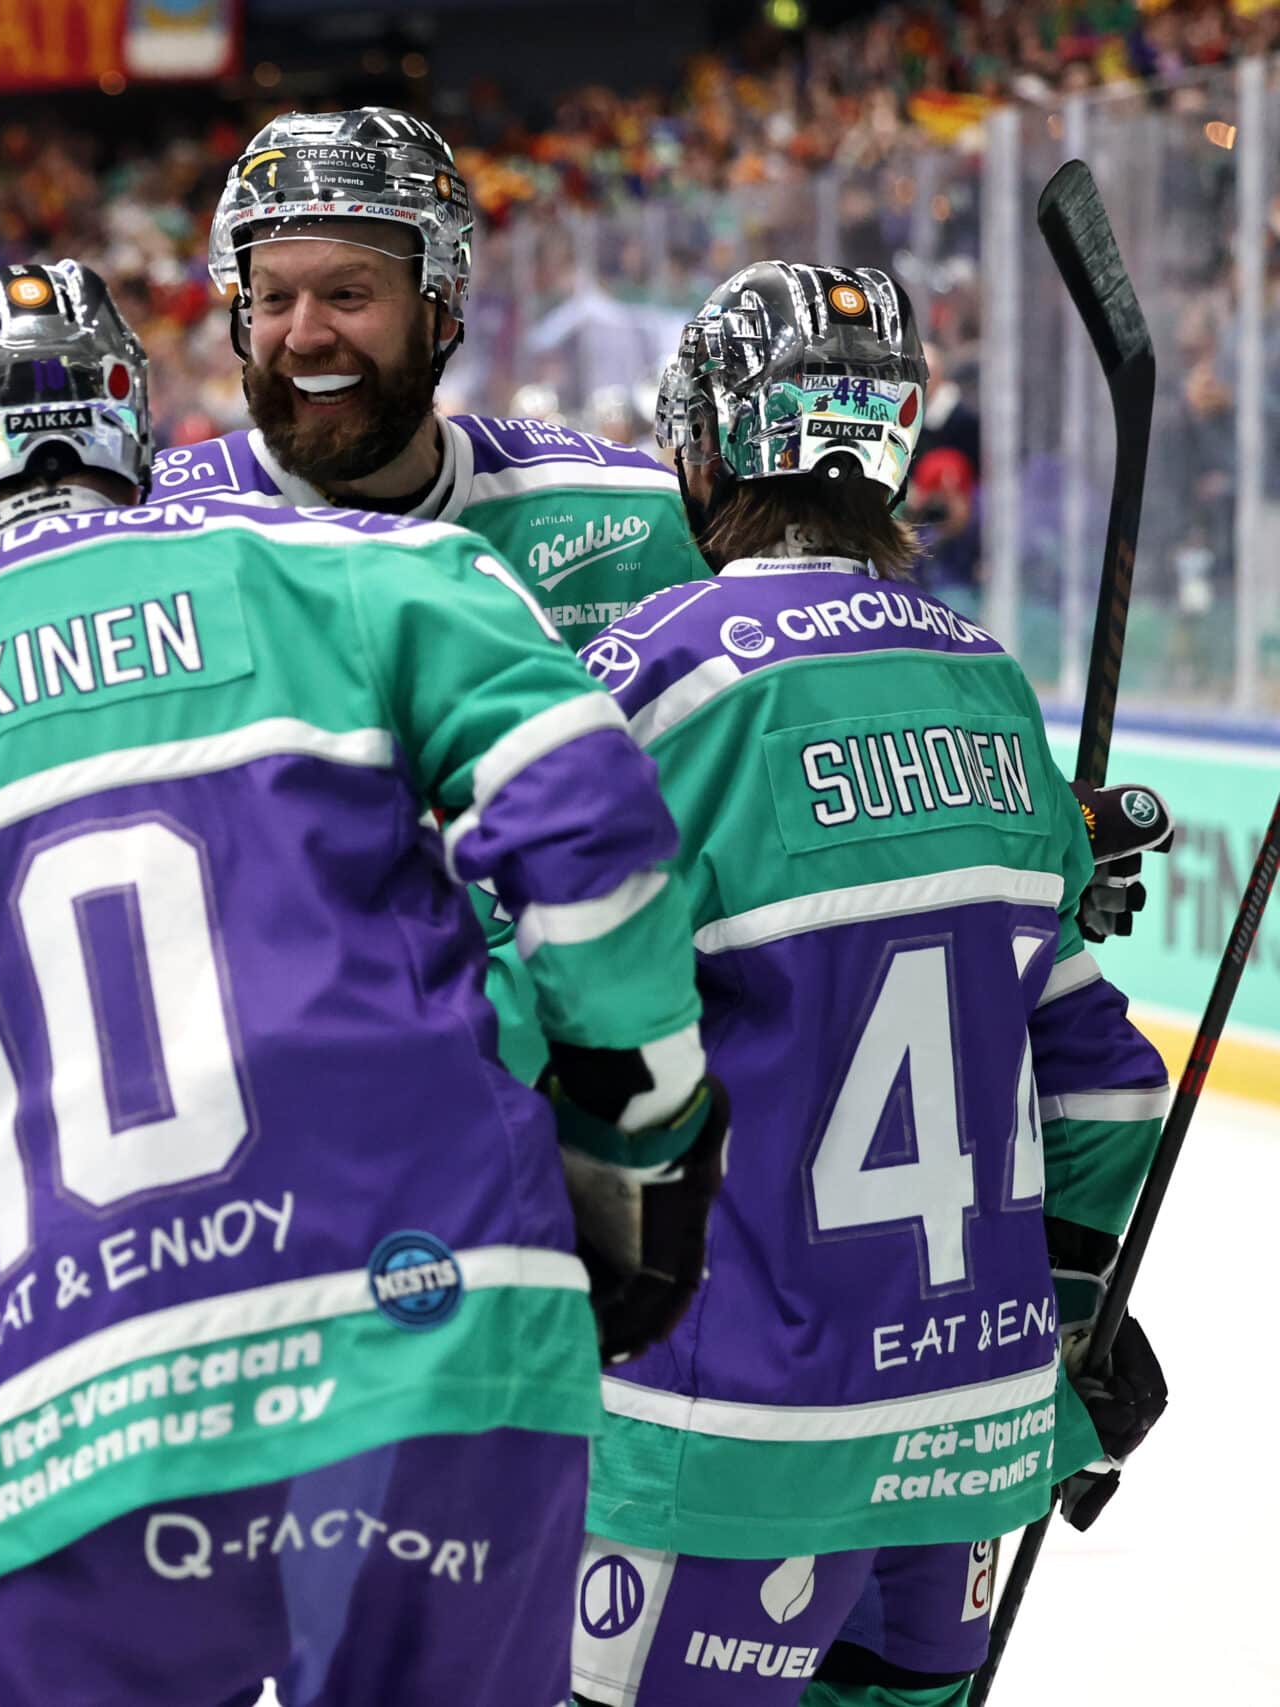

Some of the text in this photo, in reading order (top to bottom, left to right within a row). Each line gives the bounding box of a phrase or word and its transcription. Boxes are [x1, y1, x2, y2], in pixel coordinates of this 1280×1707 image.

[296, 149, 377, 163] CREATIVE
[320, 174, 337, 184] Live
[337, 176, 365, 187] Events
[365, 205, 418, 221] GLASSDRIVE
[833, 377, 869, 407] 44
[9, 411, 87, 431] PAIKKA
[811, 421, 878, 438] PAIKKA
[524, 430, 583, 448] link
[529, 514, 574, 528] LAITILAN
[528, 514, 651, 578] Kukko
[55, 1256, 92, 1311] &
[98, 1191, 294, 1292] ENJOY
[374, 1259, 458, 1302] MESTIS
[873, 1314, 967, 1372] EAT
[977, 1309, 993, 1352] &
[0, 1330, 323, 1469] Itä-Vantaan
[254, 1377, 338, 1427] Oy
[144, 1509, 491, 1586] Q-FACTORY
